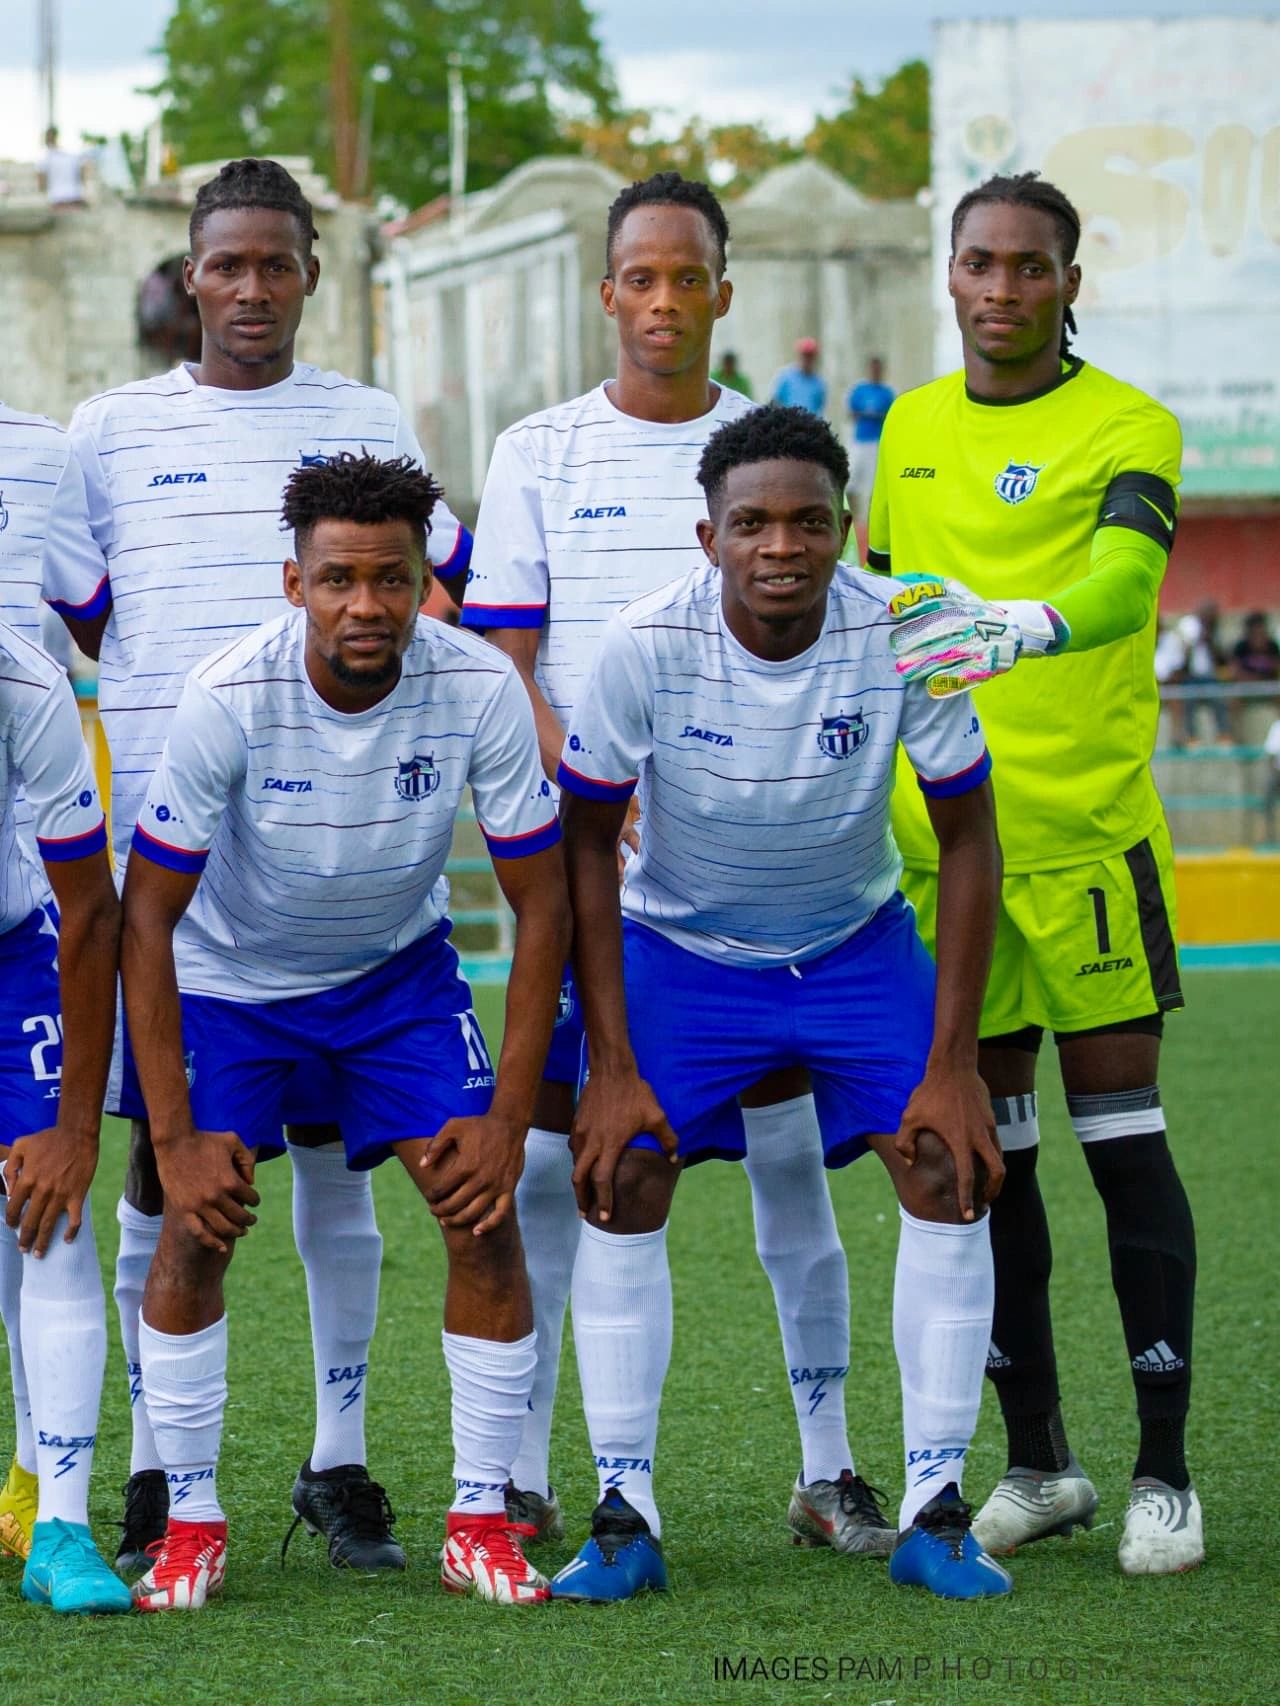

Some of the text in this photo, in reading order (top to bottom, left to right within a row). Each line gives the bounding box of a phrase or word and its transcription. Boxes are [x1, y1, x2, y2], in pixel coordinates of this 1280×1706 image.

[147, 472, 207, 487] SAETA
[899, 467, 936, 479] SAETA
[568, 506, 626, 520] SAETA
[677, 725, 733, 746] SAETA
[261, 778, 312, 792] SAETA
[1087, 886, 1111, 955] 1
[1074, 957, 1133, 977] SAETA
[22, 1013, 63, 1081] 2
[1132, 1358, 1184, 1371] adidas
[907, 1448, 967, 1467] SAET
